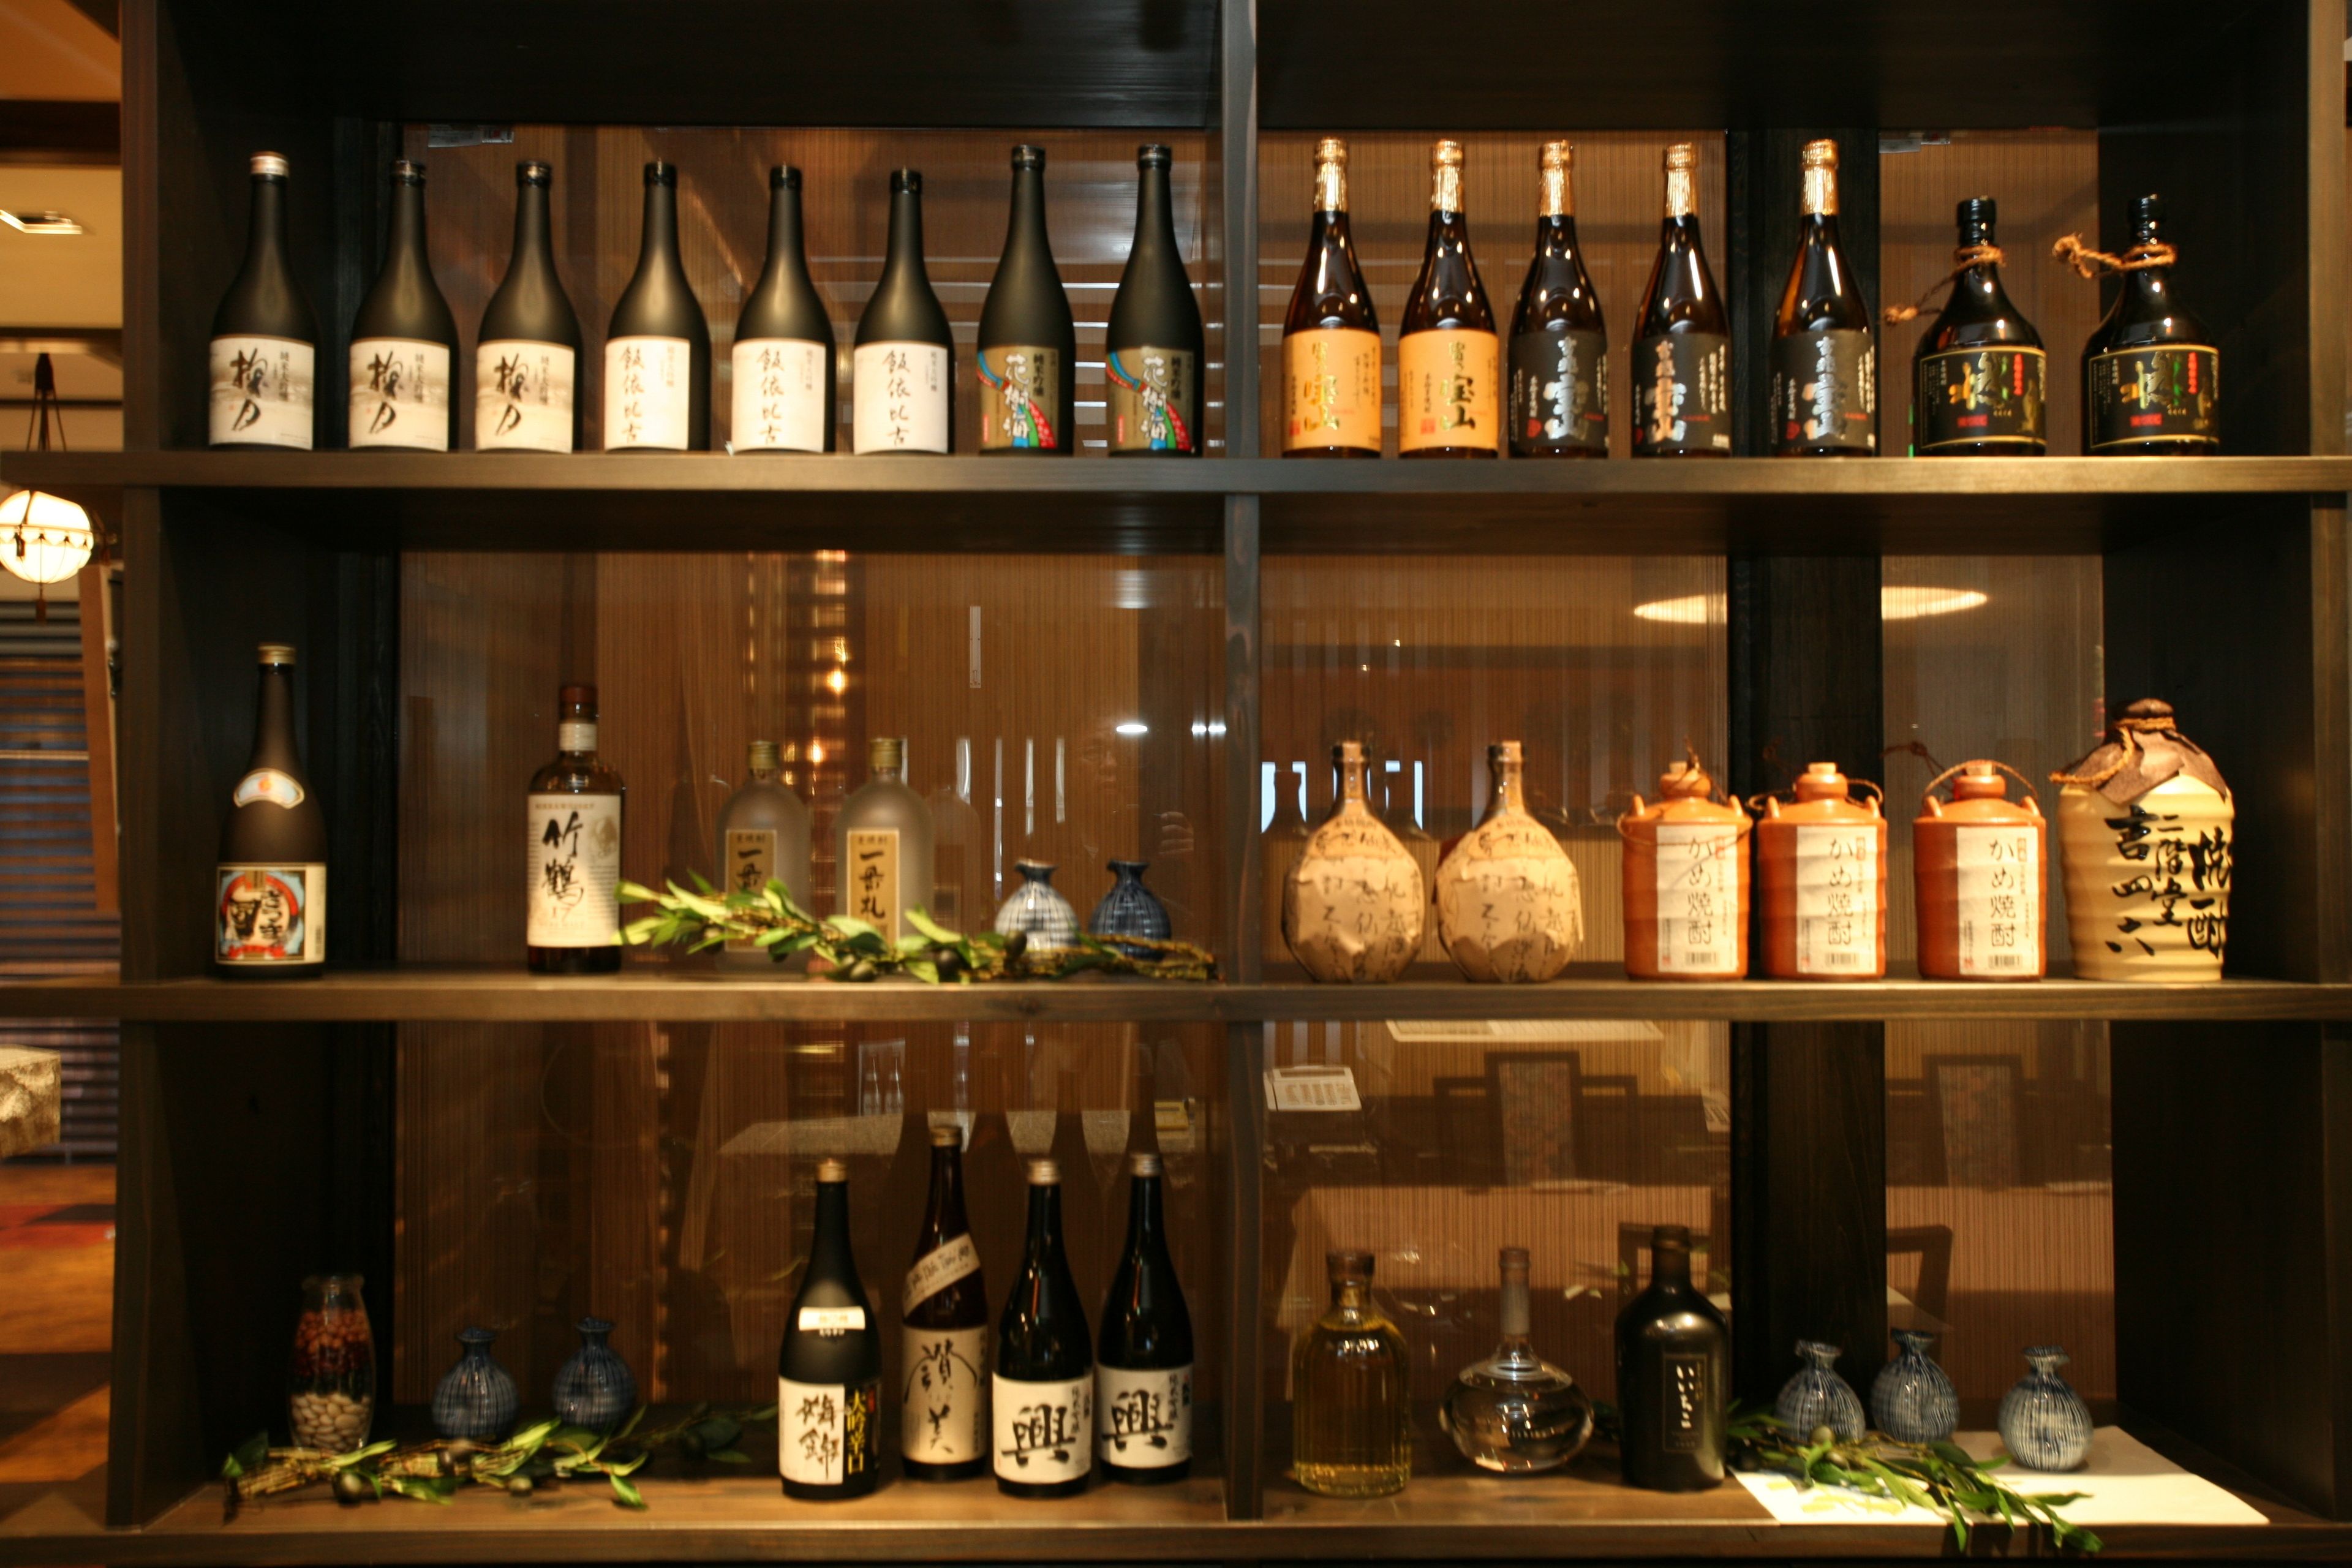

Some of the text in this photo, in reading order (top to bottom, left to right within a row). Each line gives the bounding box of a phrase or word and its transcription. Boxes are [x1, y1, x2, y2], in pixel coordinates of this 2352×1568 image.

[756, 348, 785, 445] 飯依比古
[882, 350, 912, 446] 飯依比古
[541, 811, 584, 907] 竹鶴
[1688, 837, 1714, 945] かめ焼酎
[1828, 837, 1854, 946] かめ焼酎
[1989, 839, 2016, 948] かめ焼酎
[2105, 804, 2158, 957] 吉四六
[2152, 813, 2188, 928] 二階堂
[795, 1393, 840, 1480] 梅錦
[1000, 1403, 1076, 1467] 興
[1101, 1389, 1174, 1452] 興
